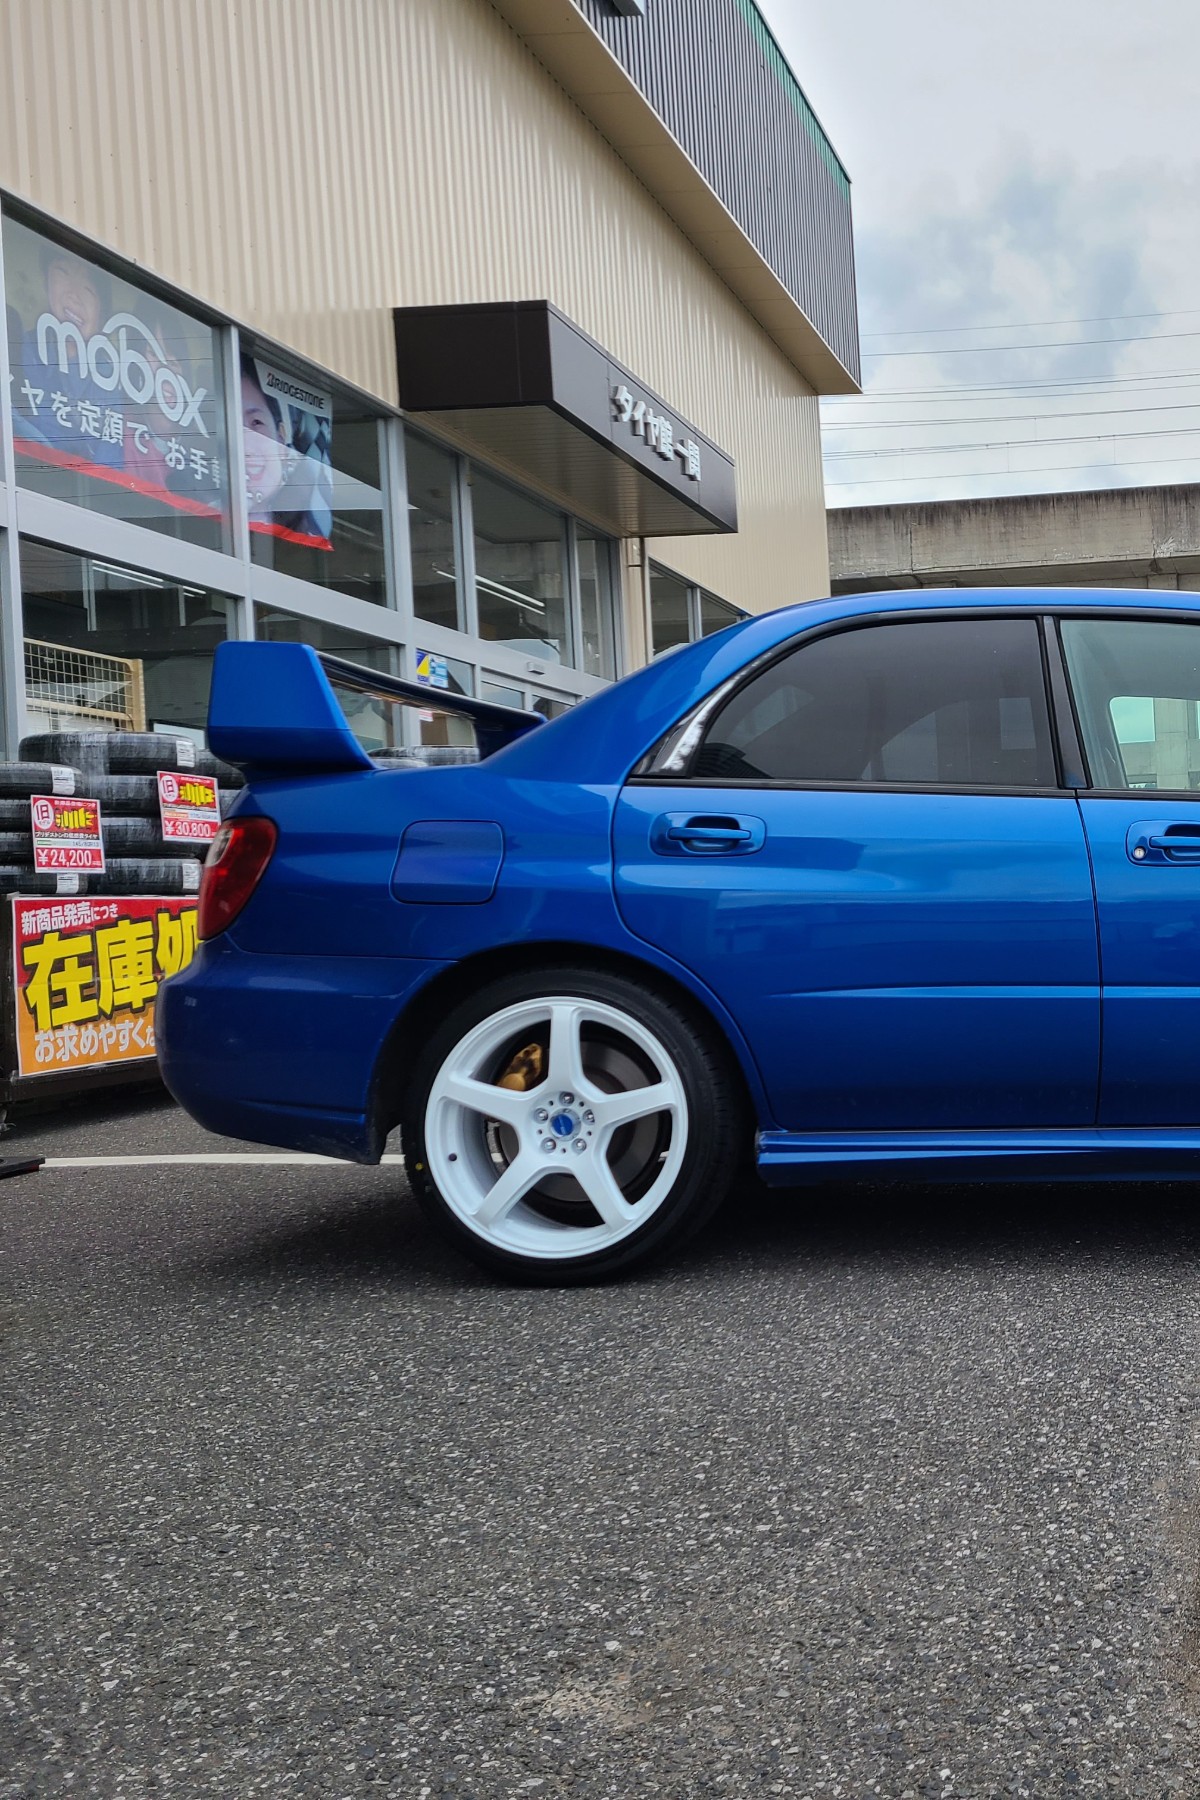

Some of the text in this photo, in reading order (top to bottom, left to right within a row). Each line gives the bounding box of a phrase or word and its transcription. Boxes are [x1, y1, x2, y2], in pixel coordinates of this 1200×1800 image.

[37, 313, 210, 438] mobox
[266, 372, 325, 410] BRIDGESTONE
[10, 374, 150, 454] ヤを定額で
[39, 849, 92, 867] ¥24,200
[21, 901, 118, 935] 新商品発売につき
